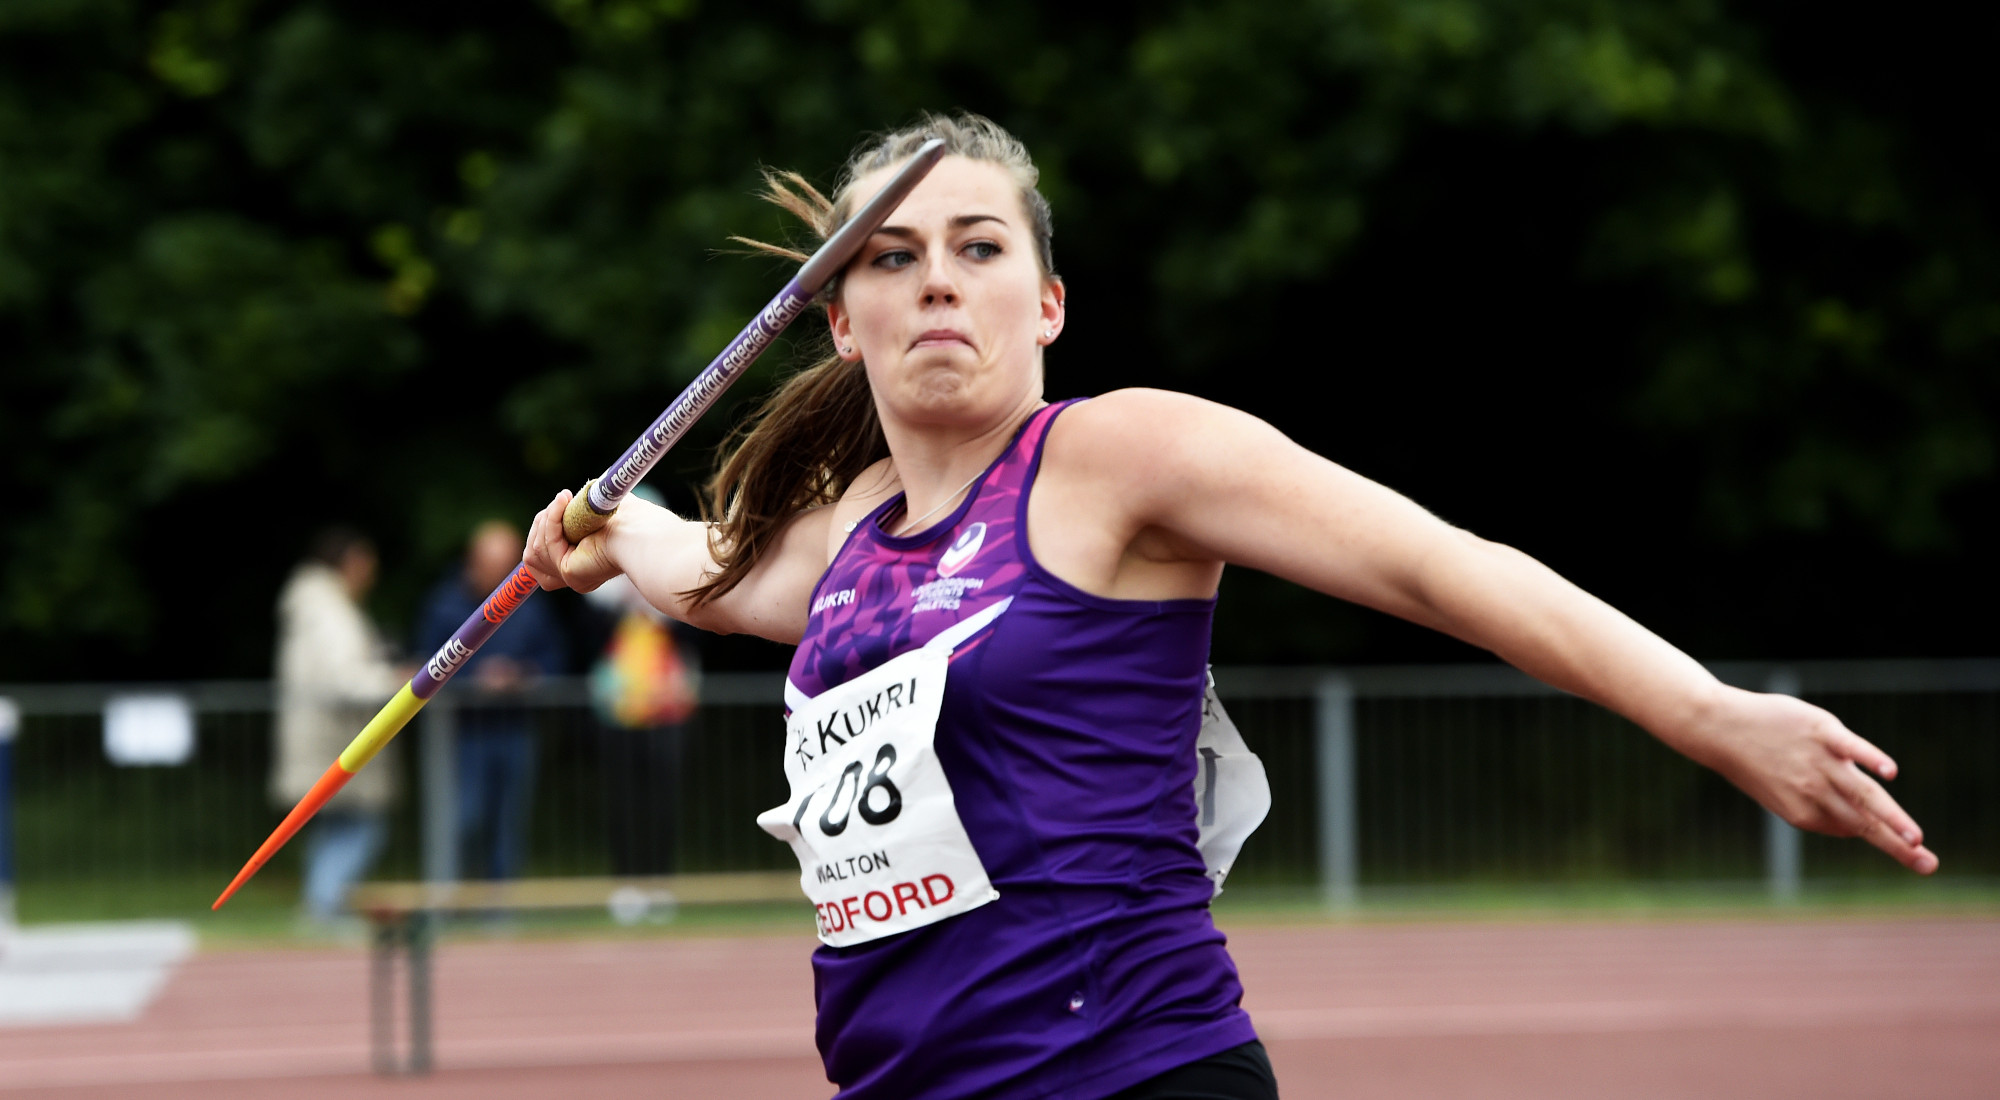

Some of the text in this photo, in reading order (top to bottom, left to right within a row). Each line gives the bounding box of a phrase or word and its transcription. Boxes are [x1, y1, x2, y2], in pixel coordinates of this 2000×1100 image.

[611, 294, 805, 491] nemeth competition special 85m
[427, 637, 474, 682] 600g
[817, 677, 917, 756] KUKRI
[816, 850, 890, 884] WALTON
[816, 873, 955, 935] EDFORD
